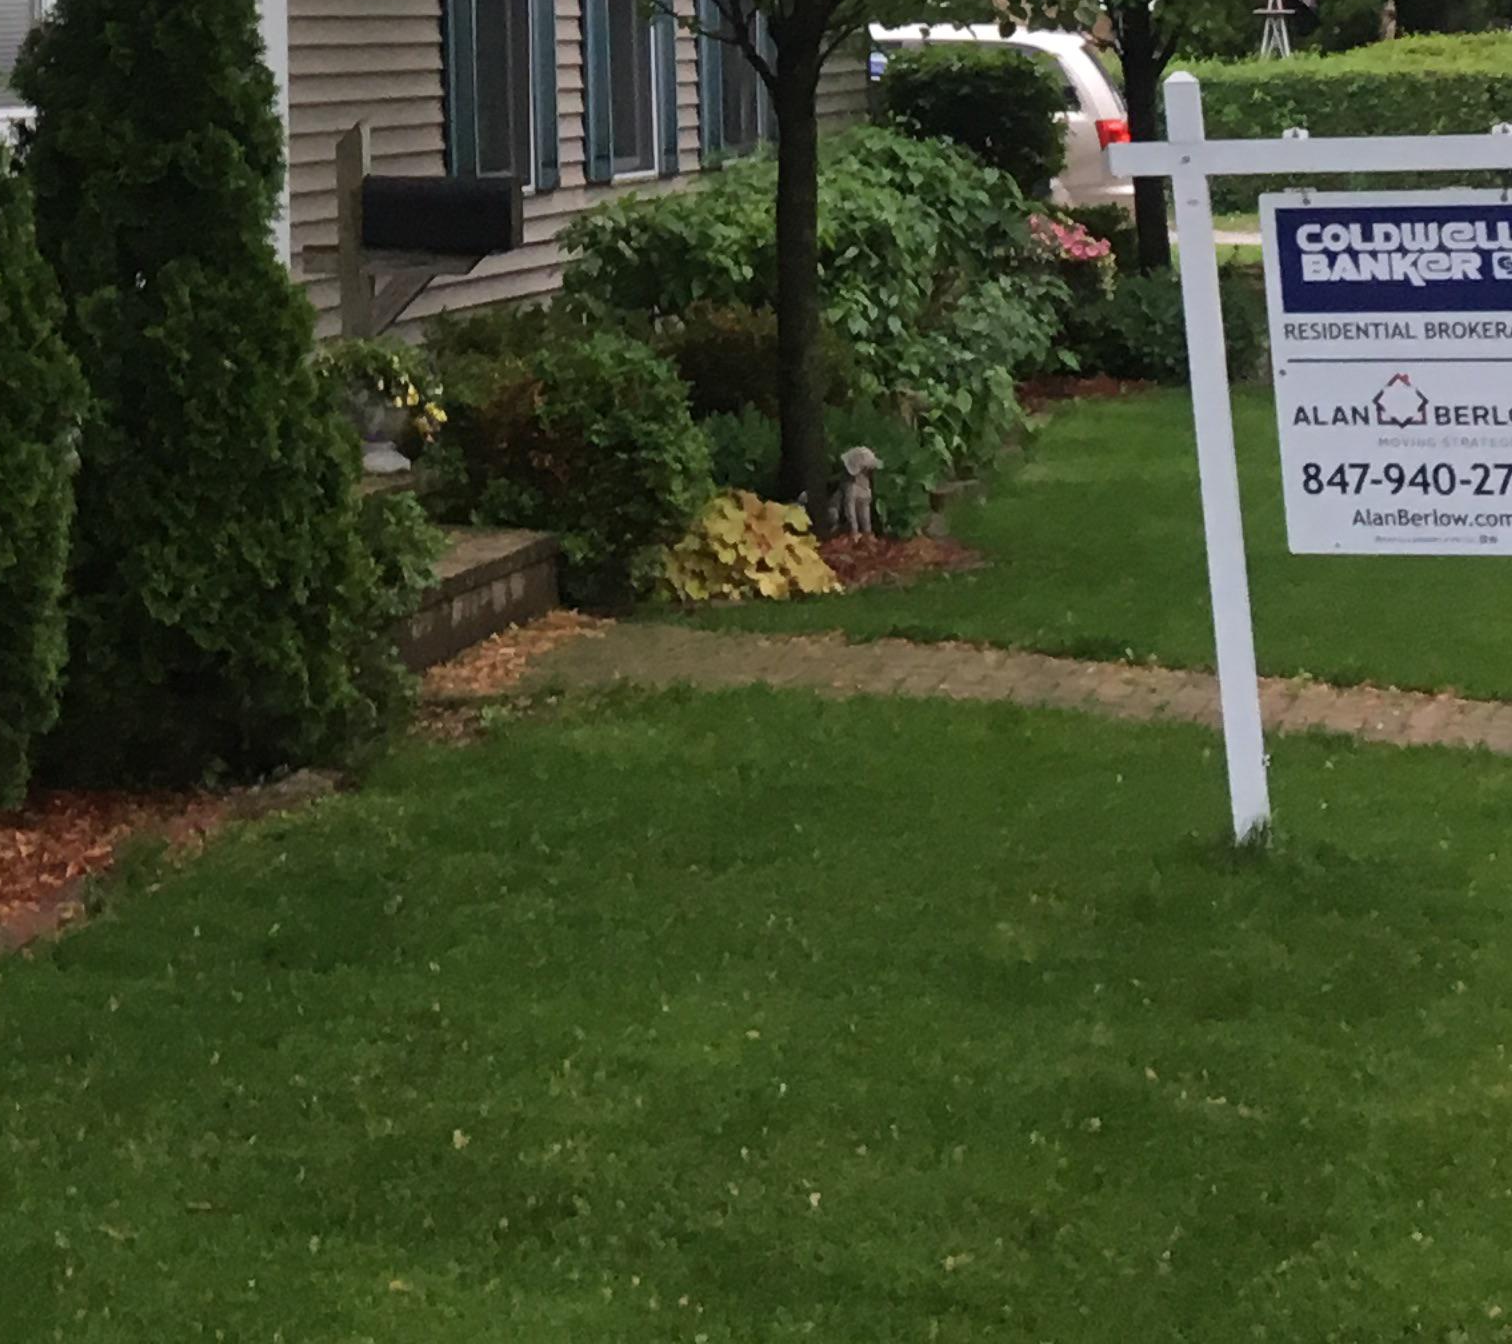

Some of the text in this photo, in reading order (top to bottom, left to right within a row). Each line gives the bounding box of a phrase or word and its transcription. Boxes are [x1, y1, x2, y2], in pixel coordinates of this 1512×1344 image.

[1301, 252, 1483, 286] BANKER
[1284, 322, 1417, 340] RESIDENTIAL
[1292, 405, 1512, 426] ALAN BERL
[1441, 436, 1512, 449] STRATEG
[1302, 462, 1512, 496] 847-940-27
